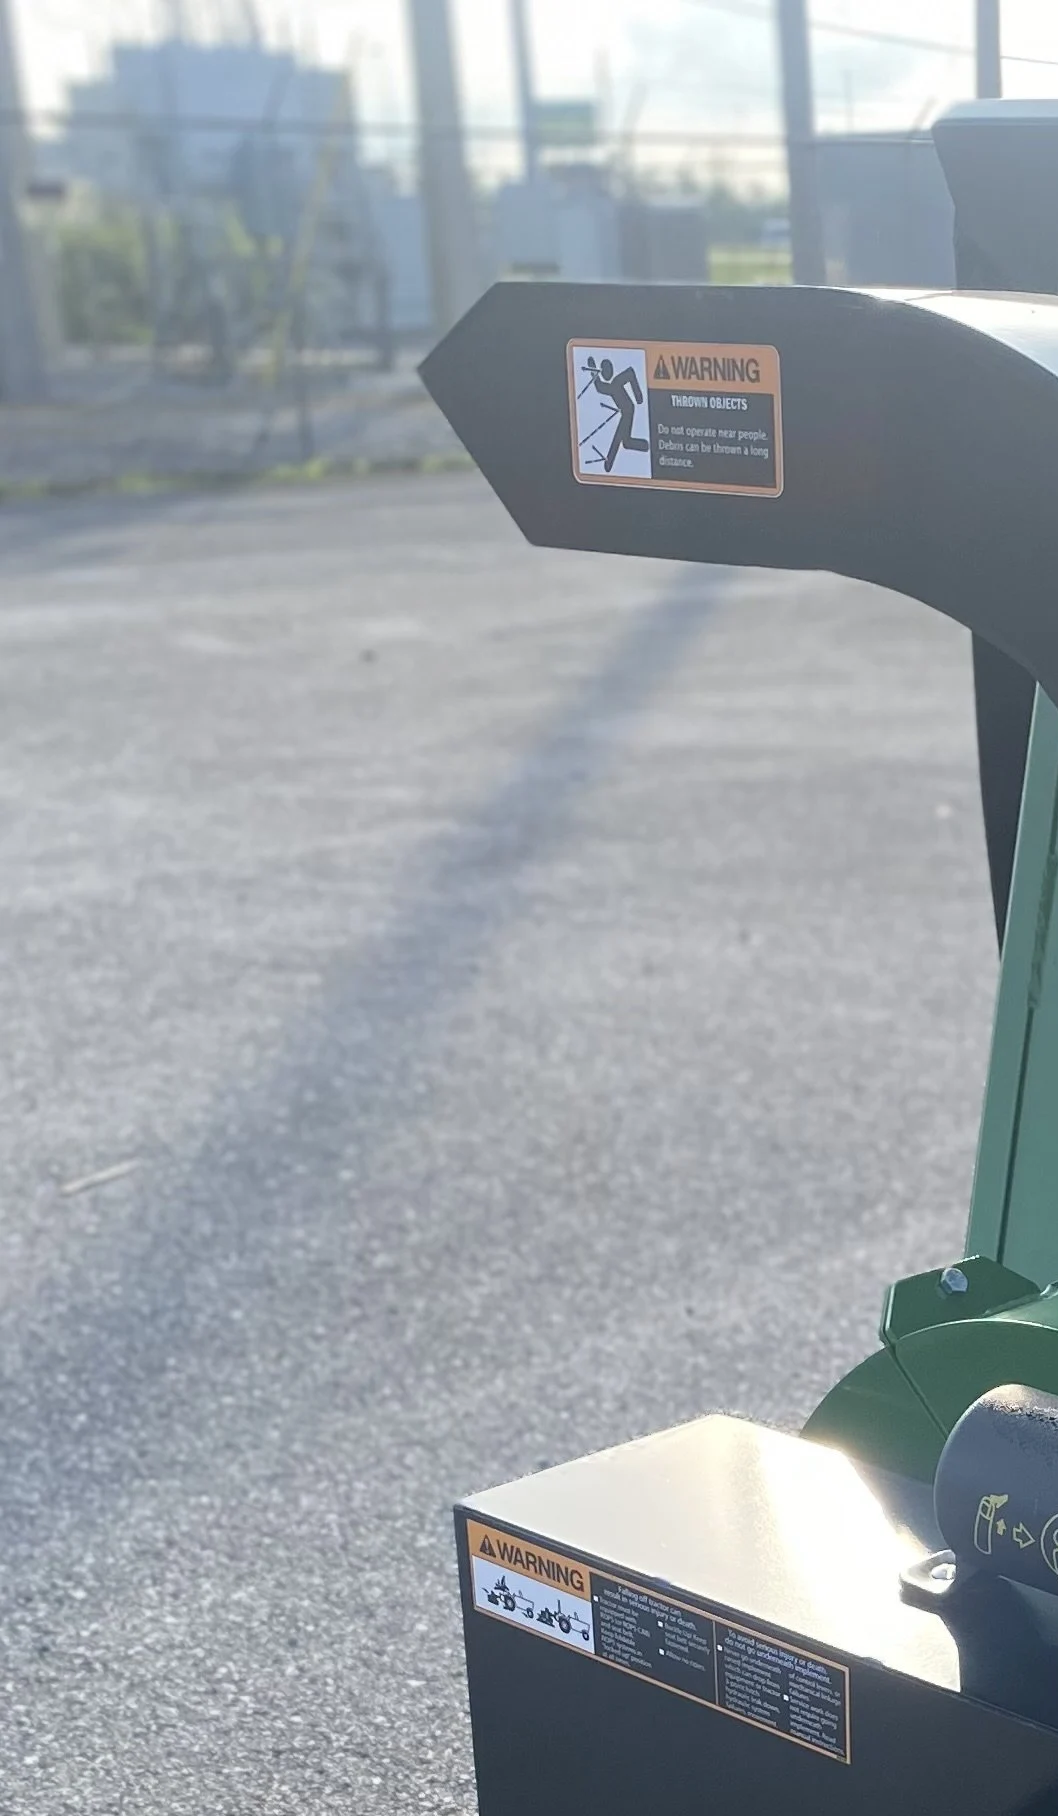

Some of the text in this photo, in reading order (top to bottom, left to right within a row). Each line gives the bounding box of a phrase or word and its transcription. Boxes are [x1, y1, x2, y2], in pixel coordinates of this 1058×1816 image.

[670, 356, 760, 383] WARNING
[671, 394, 748, 411] THROWN OBJECTS
[658, 424, 768, 441] Do not operate near people.
[658, 440, 769, 459] Debris can be thrown a long
[659, 456, 694, 467] distance.
[497, 1539, 585, 1593] WARNING
